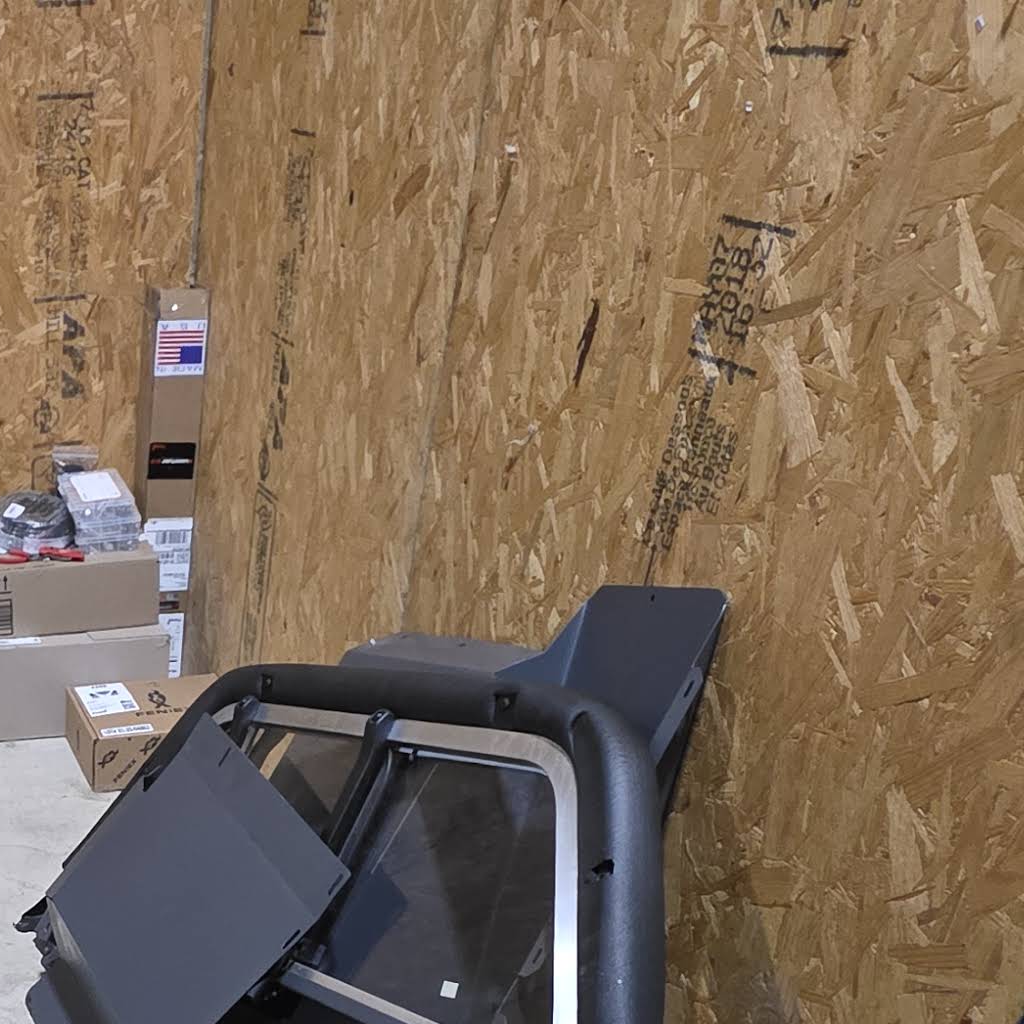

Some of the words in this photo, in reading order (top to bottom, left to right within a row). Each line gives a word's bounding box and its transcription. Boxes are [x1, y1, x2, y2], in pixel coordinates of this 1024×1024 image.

[78, 157, 91, 190] CAT
[719, 247, 752, 336] 2018
[135, 706, 187, 718] FENIE
